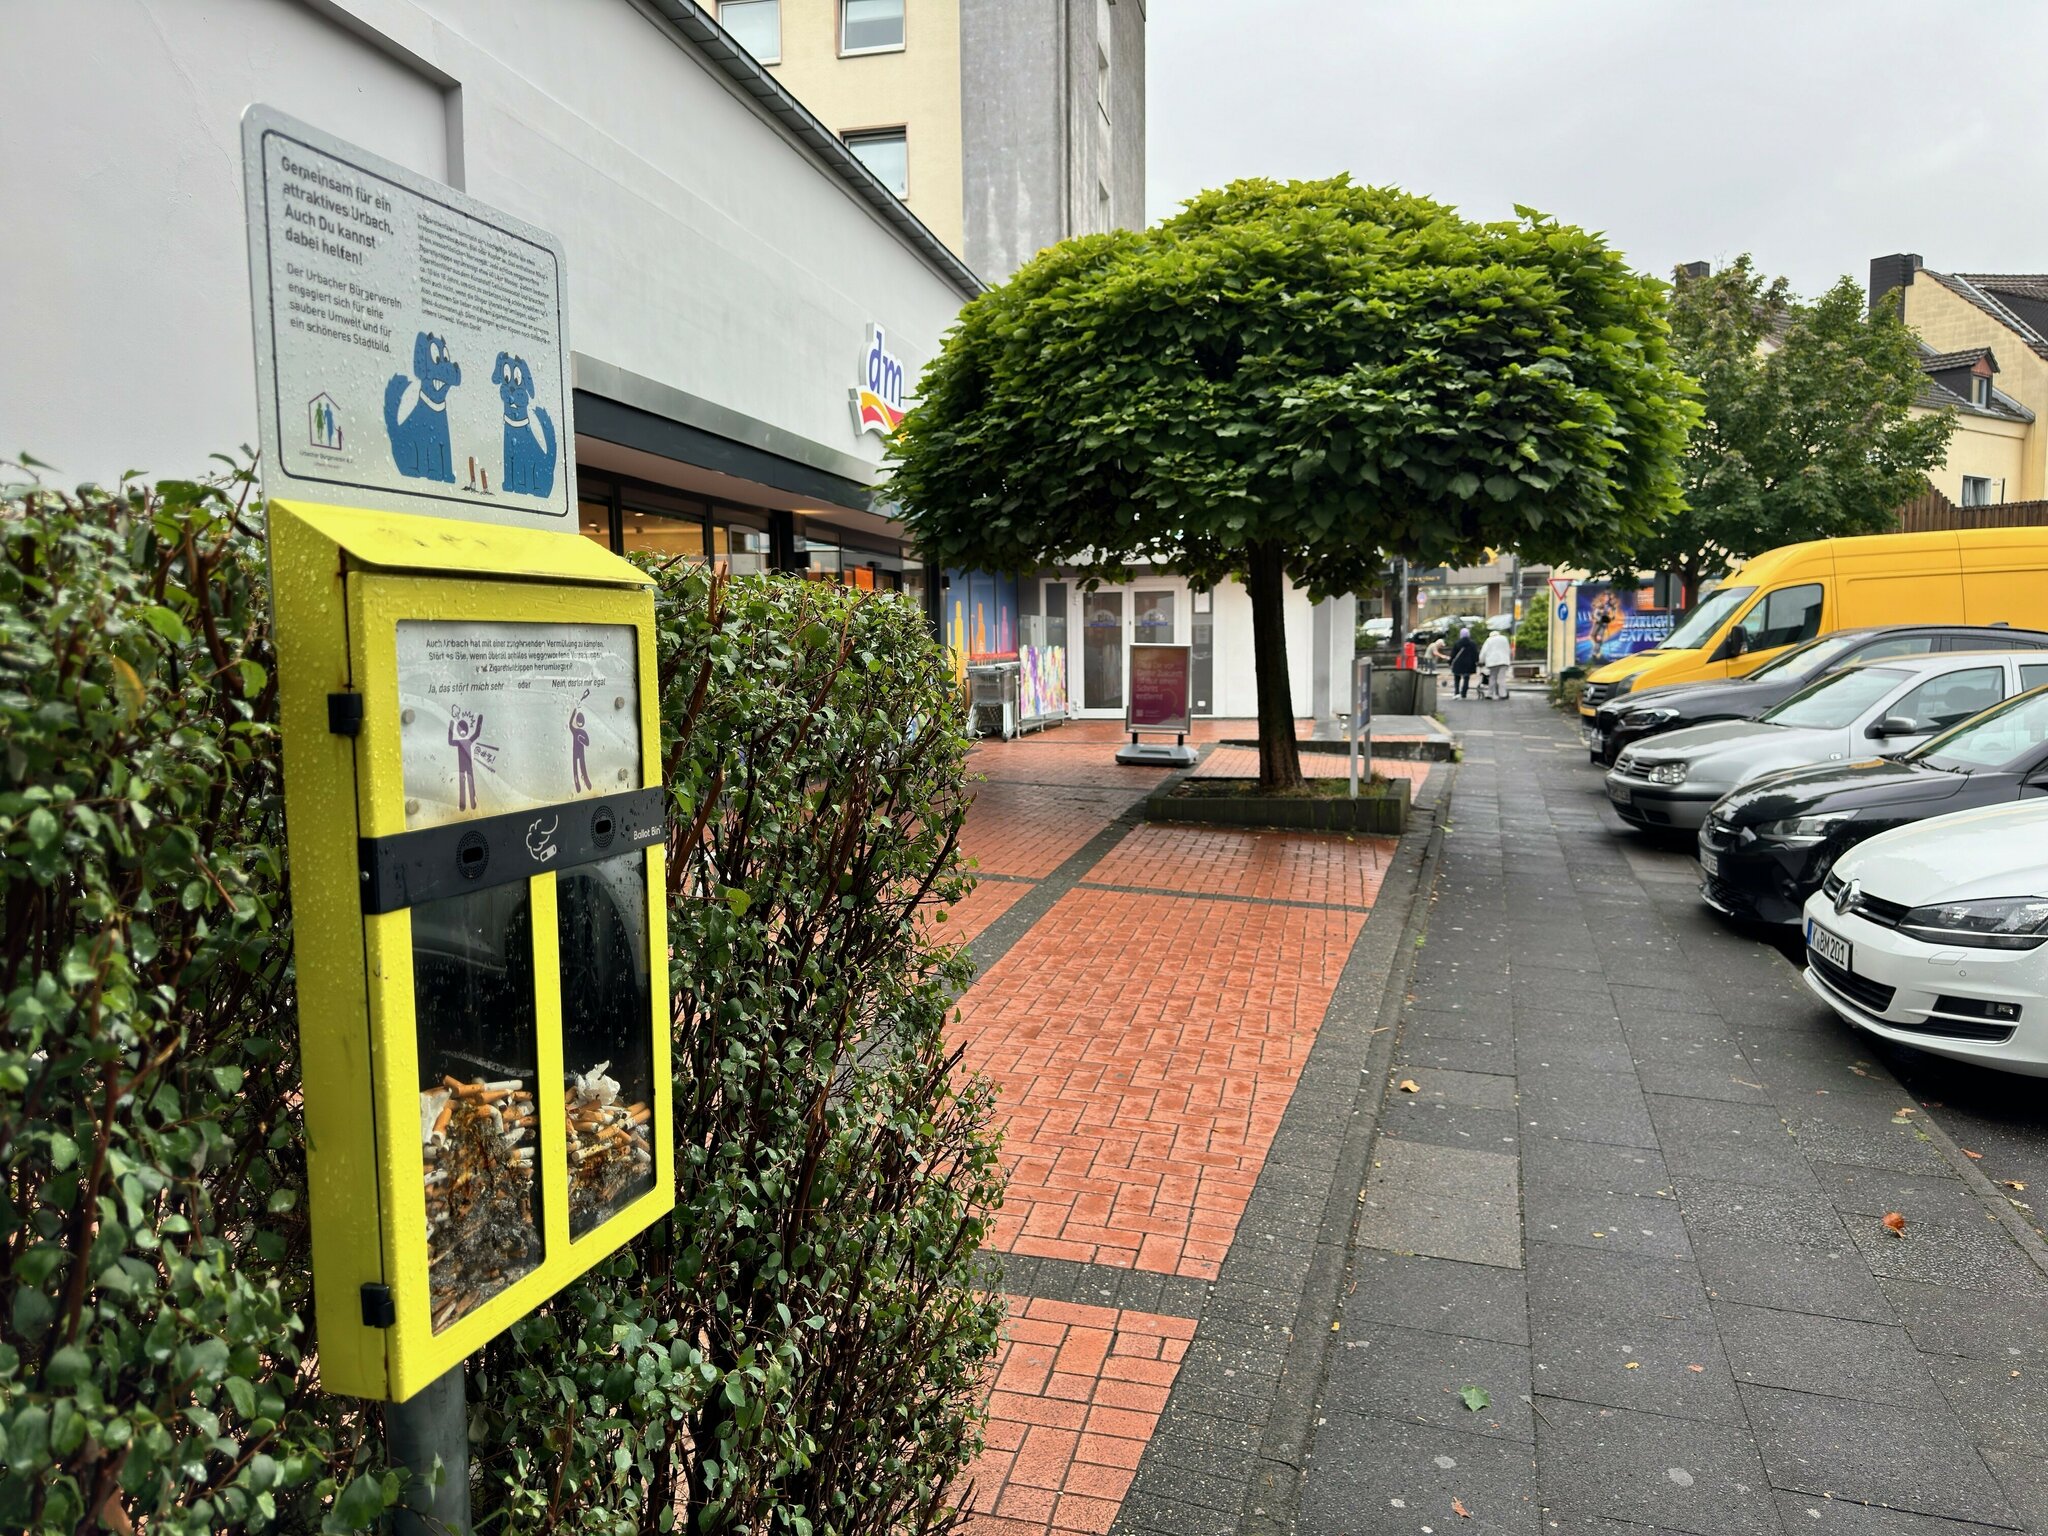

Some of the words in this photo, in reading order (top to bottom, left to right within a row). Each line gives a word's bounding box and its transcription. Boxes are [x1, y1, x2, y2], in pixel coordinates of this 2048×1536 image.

[281, 156, 353, 198] Gemeinsam
[355, 186, 372, 204] für
[375, 197, 391, 213] ein
[282, 182, 349, 217] attraktives
[351, 205, 394, 235] Urbach.
[285, 203, 316, 227] Auch
[319, 215, 335, 234] Du
[337, 222, 376, 249] kannst
[285, 227, 319, 251] dabei
[322, 239, 363, 266] helfen!
[287, 262, 304, 278] Der
[306, 268, 347, 292] Urbacher
[349, 282, 402, 310] Bürgerverein
[288, 283, 332, 304] engagiert
[333, 295, 351, 309] sich
[352, 300, 364, 314] für
[366, 307, 384, 320] eine
[289, 301, 326, 319] saubere
[328, 309, 361, 329] Umwelt
[363, 322, 378, 334] und
[380, 324, 392, 338] für
[290, 318, 304, 329] ein
[306, 322, 352, 343] schöneres
[353, 333, 391, 353] Stadtbild.
[869, 330, 902, 408] dm
[426, 639, 442, 648] Auch
[470, 639, 481, 648] hat
[482, 640, 492, 648] mit
[1618, 628, 1668, 642] EXPRES
[428, 651, 444, 661] Stört
[469, 652, 487, 660] wenn
[428, 683, 437, 695] Ja,
[438, 682, 450, 693] das
[451, 681, 469, 692] stört
[470, 681, 489, 692] mich
[490, 681, 504, 691] sehr
[517, 681, 531, 689] oder
[593, 678, 606, 687] egal
[633, 828, 651, 841] Ballot
